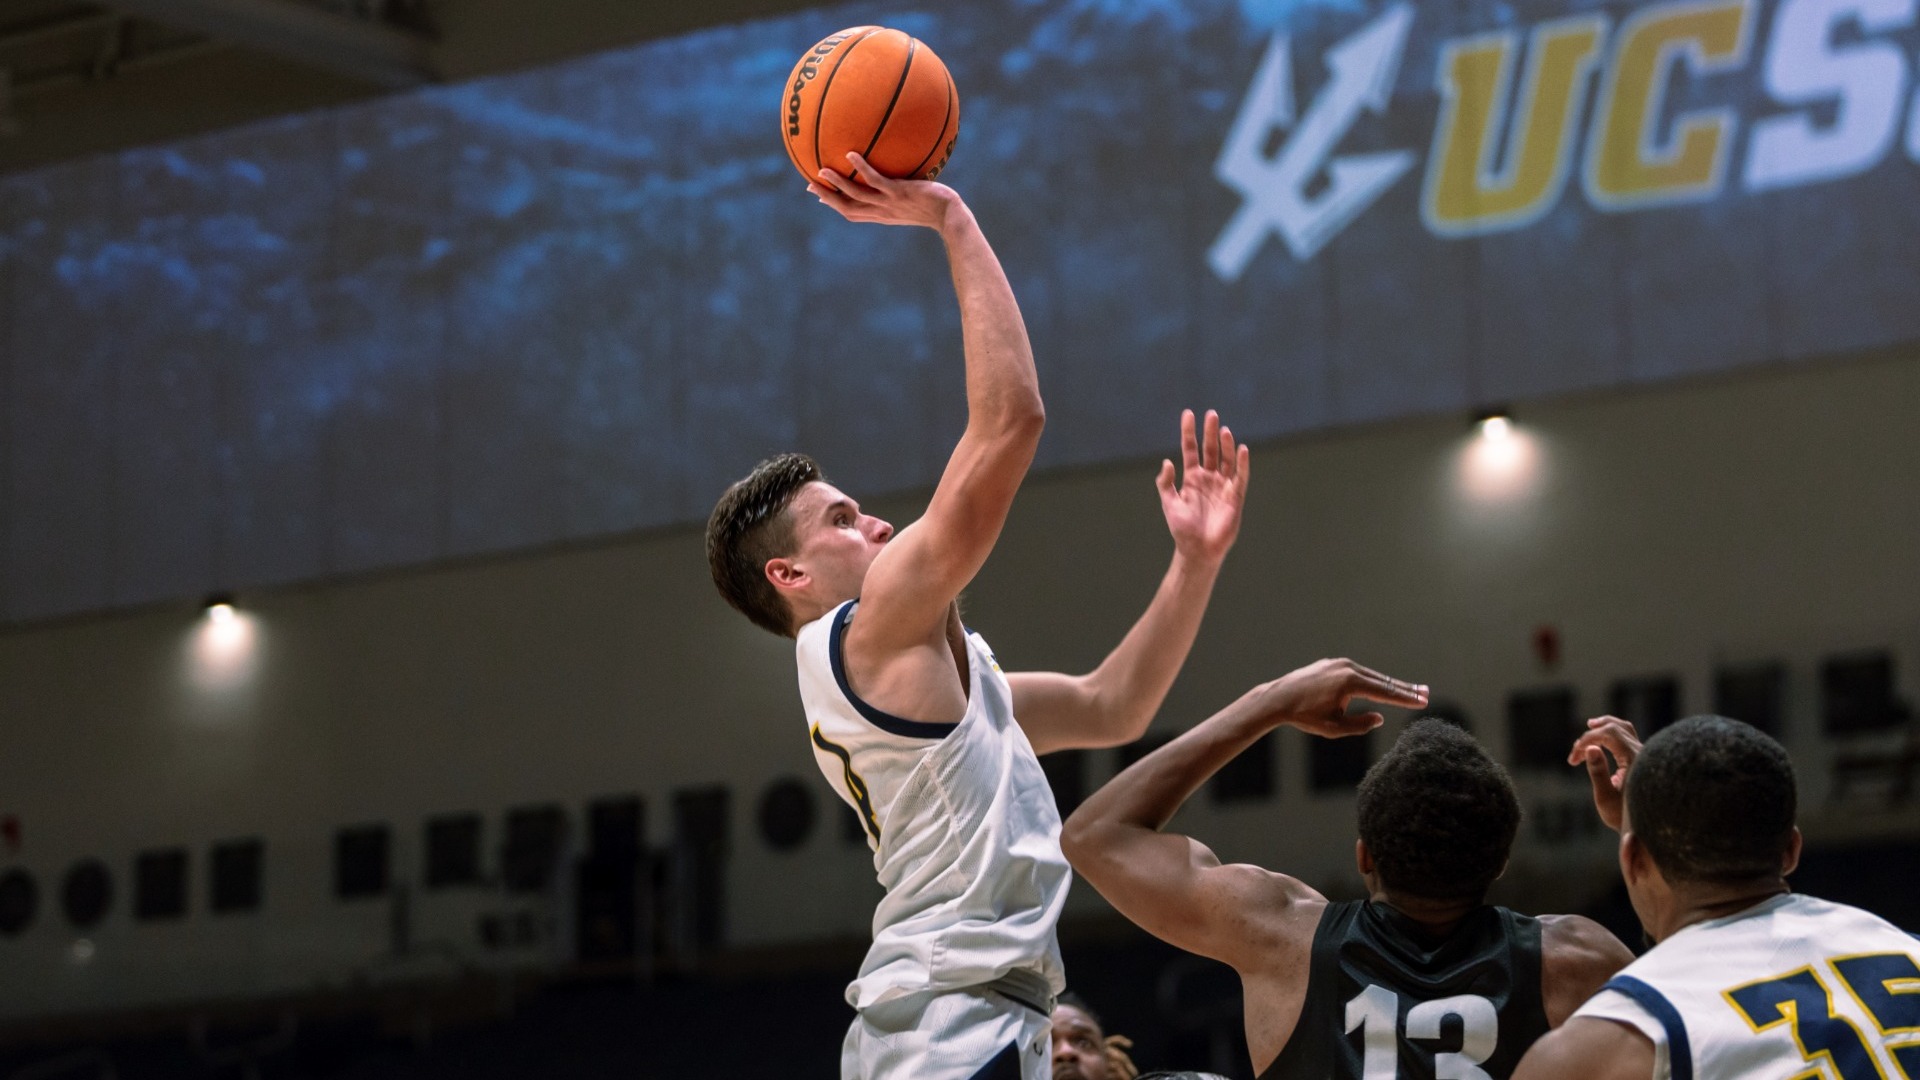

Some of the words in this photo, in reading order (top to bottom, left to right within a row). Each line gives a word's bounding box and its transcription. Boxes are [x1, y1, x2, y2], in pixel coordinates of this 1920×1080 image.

[788, 31, 854, 137] Wilson
[1419, 0, 1920, 239] UCS
[1344, 983, 1498, 1080] 13
[1720, 951, 1920, 1080] 35
